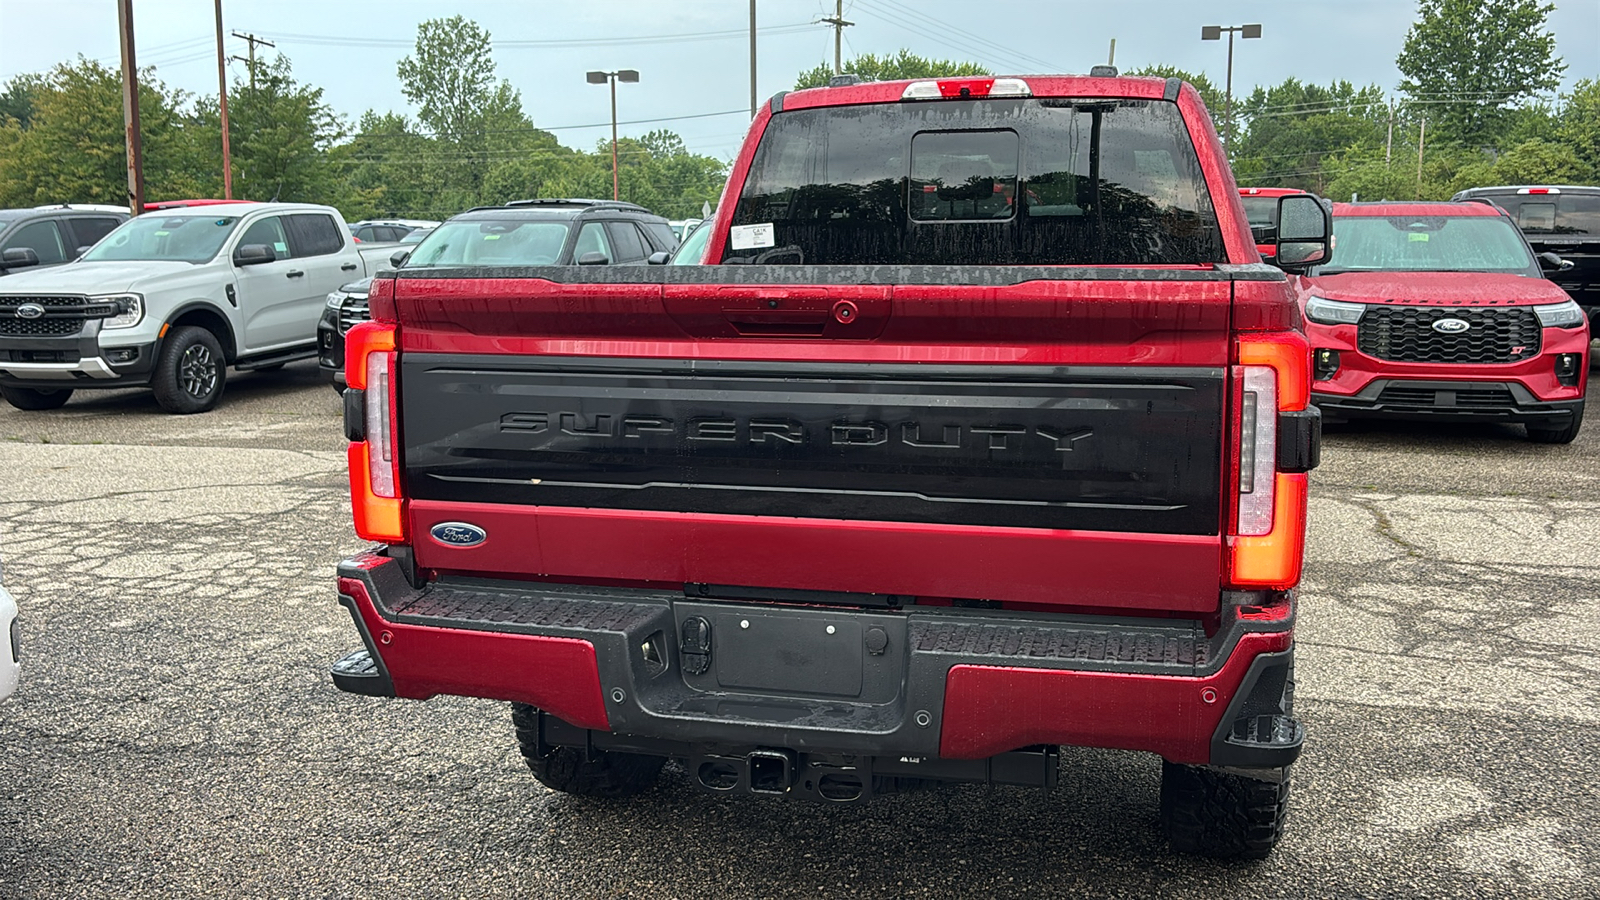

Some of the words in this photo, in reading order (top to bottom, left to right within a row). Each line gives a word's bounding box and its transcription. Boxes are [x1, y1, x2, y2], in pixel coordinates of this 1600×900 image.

[1440, 322, 1462, 330] Ford
[499, 411, 803, 444] SUPER
[831, 419, 1094, 452] DUTY
[442, 526, 473, 542] Ford
